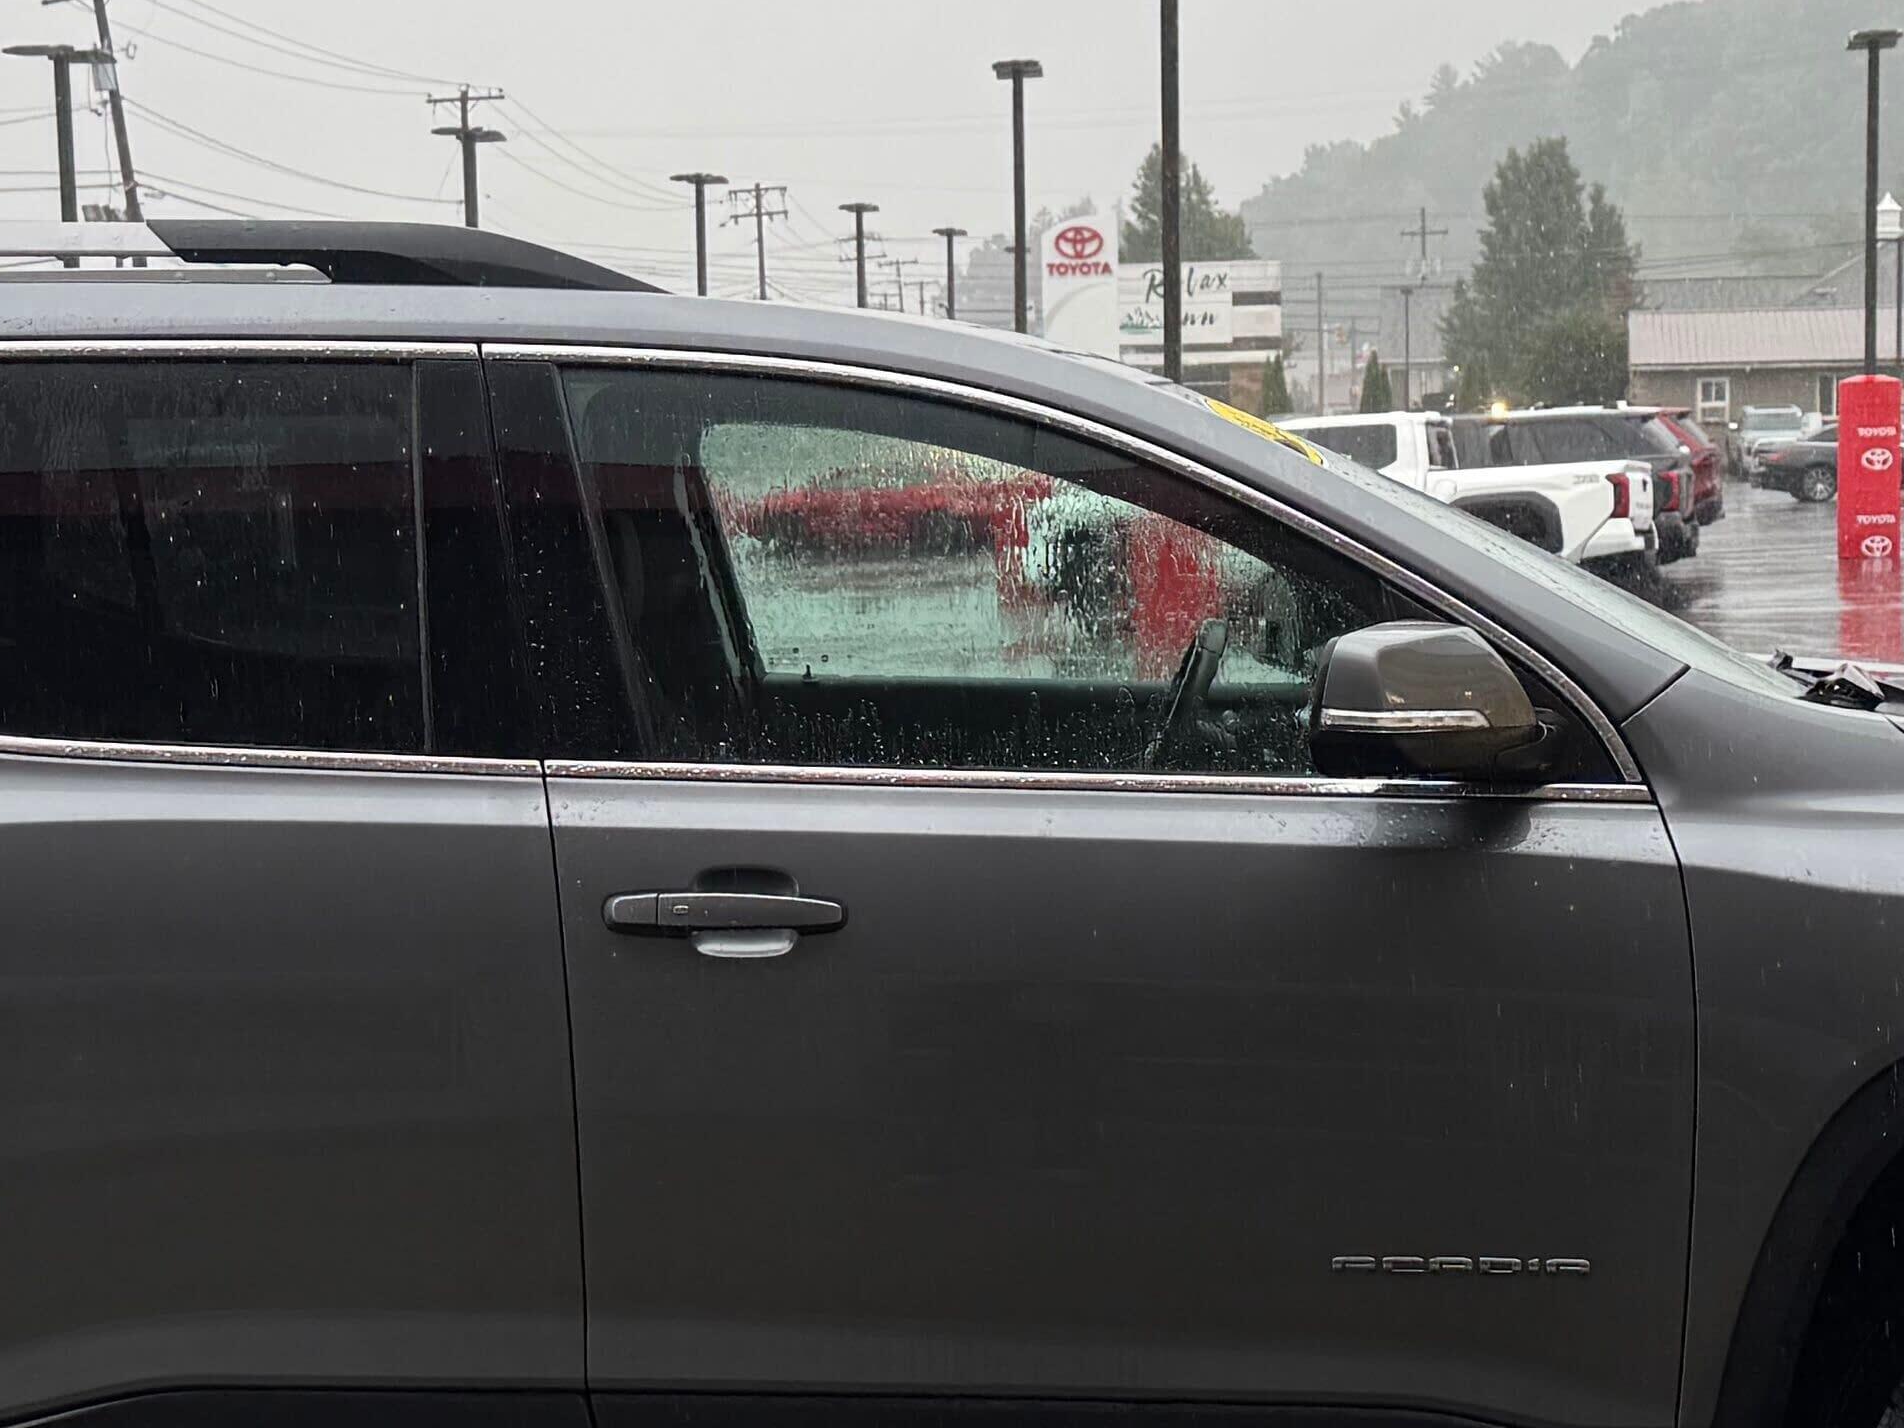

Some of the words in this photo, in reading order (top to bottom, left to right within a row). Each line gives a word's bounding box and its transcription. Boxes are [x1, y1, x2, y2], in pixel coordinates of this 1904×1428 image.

[1047, 262, 1113, 277] TOYOTA
[1143, 267, 1228, 304] Rlax
[1856, 514, 1896, 525] TOYOTA
